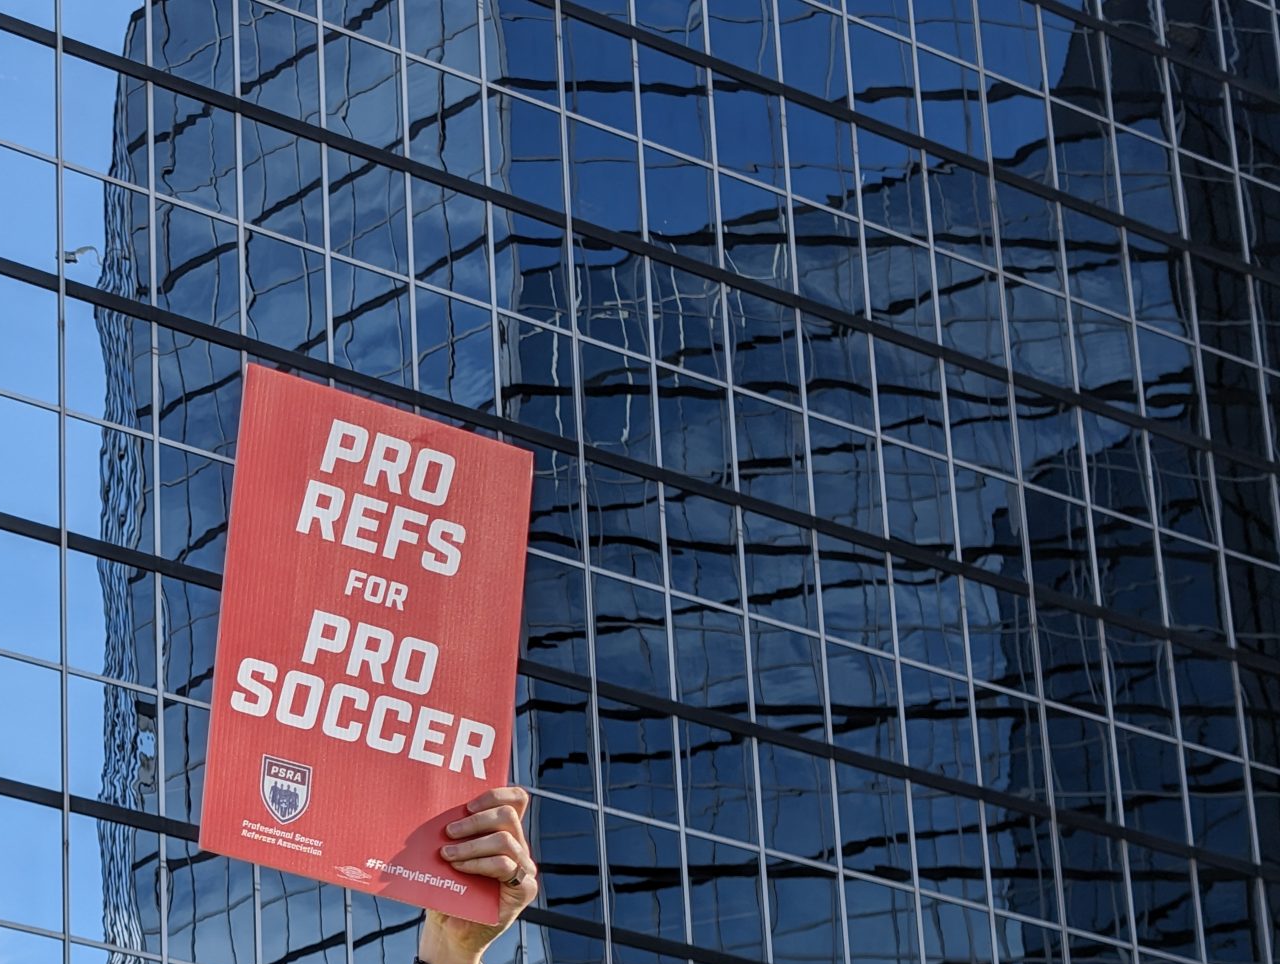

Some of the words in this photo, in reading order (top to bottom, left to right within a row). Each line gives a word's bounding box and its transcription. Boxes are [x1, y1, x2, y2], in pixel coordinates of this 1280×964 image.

[319, 419, 456, 507] PRO
[296, 480, 466, 577] REFS
[344, 570, 408, 611] FOR
[301, 609, 439, 696] PRO
[230, 657, 496, 780] SOCCER
[271, 766, 301, 782] PSRA
[242, 819, 294, 839] Professional
[366, 858, 467, 895] #FairPayIsFairPlay
